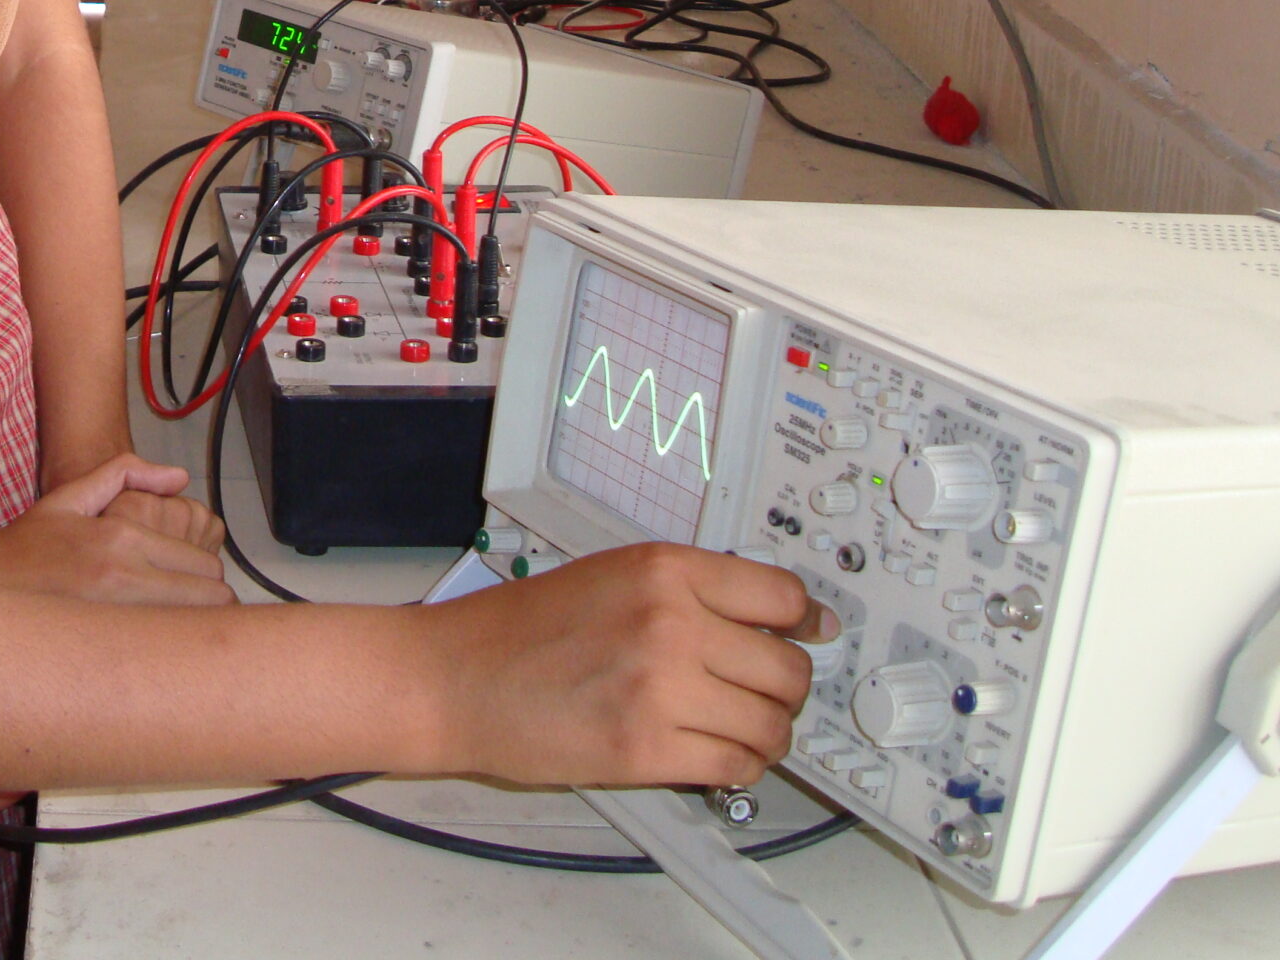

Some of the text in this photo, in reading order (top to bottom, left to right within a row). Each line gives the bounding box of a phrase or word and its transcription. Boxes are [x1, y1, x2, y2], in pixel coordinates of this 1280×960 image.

[788, 413, 816, 435] 25MHz
[774, 422, 827, 456] Oscilloscope
[783, 442, 811, 465] SM325
